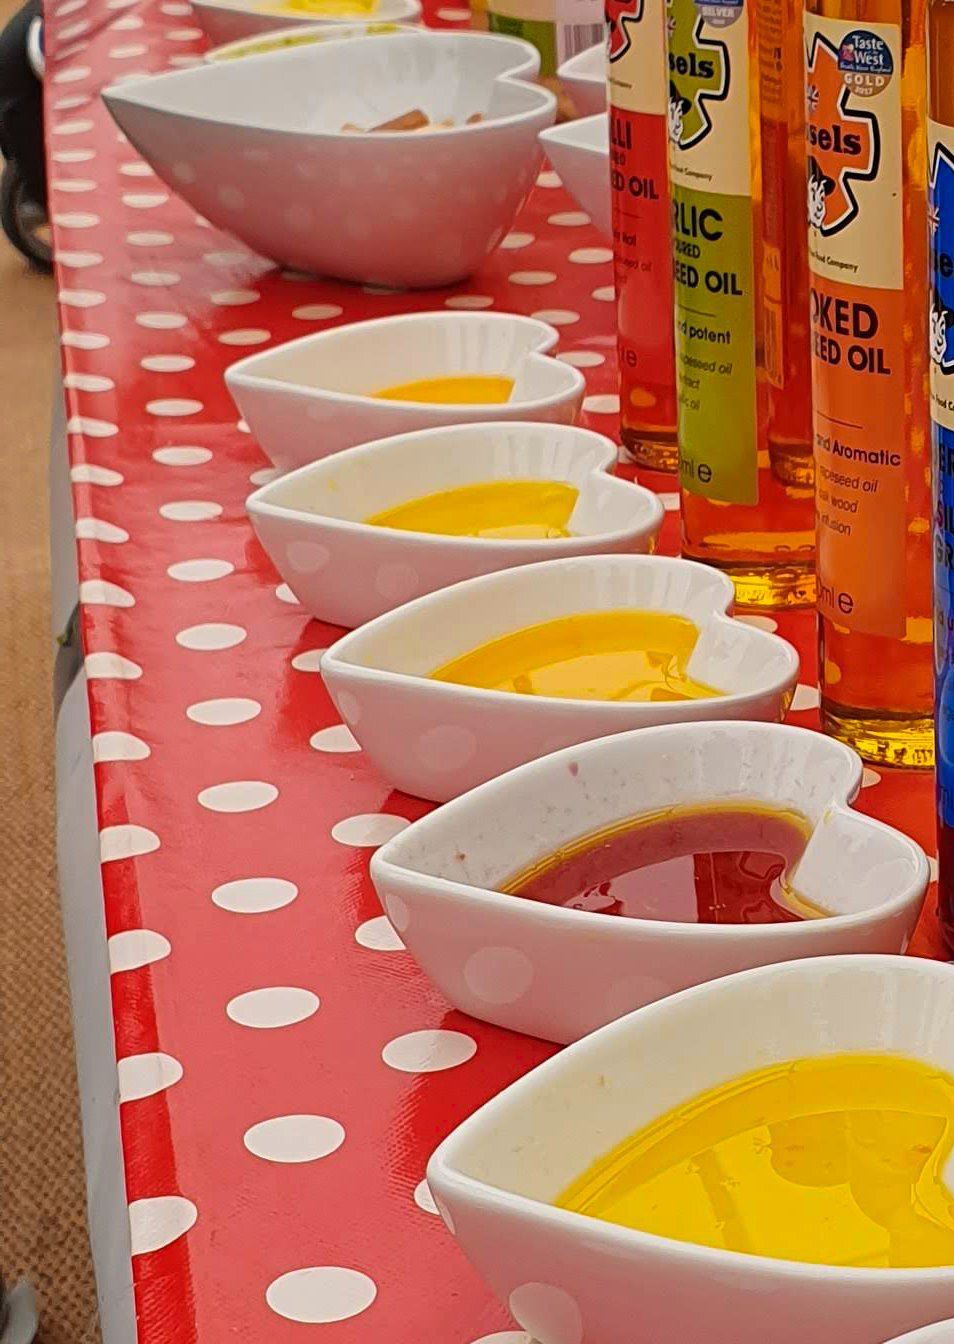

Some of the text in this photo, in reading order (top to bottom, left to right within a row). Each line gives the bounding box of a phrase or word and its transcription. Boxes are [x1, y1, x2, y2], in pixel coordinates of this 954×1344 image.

[852, 35, 885, 50] Taste
[854, 51, 885, 65] West
[844, 72, 885, 87] GOLD
[628, 174, 660, 201] OIL
[704, 270, 743, 296] OIL
[689, 325, 731, 345] potent
[847, 344, 892, 375] OIL
[832, 439, 902, 468] Aromatic
[862, 471, 880, 493] oil
[830, 493, 859, 514] wood
